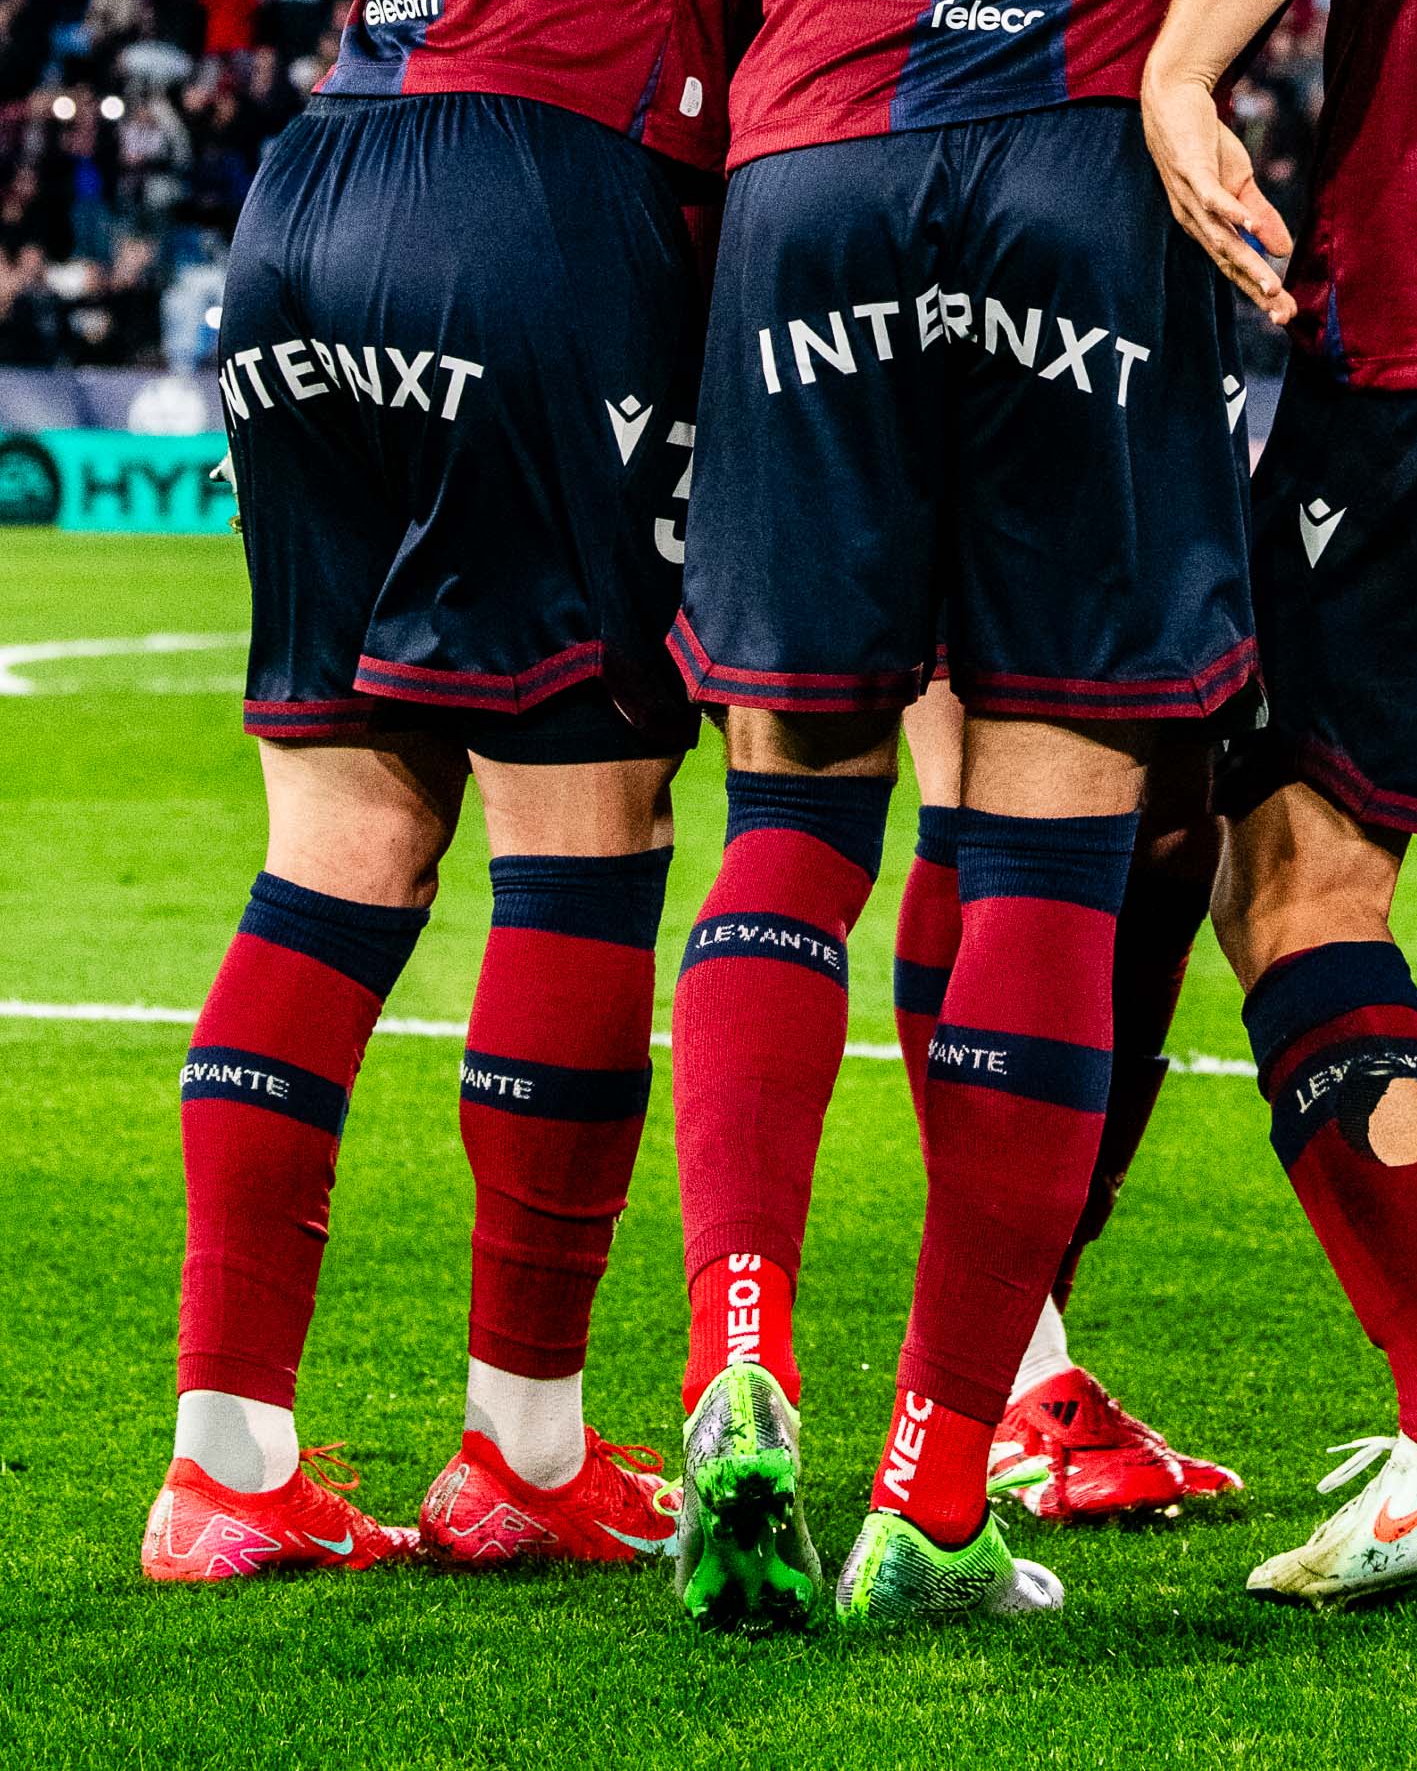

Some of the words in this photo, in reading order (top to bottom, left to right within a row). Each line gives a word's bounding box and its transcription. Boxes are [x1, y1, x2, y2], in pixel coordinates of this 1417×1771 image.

[758, 283, 1151, 407] INTERNXT
[219, 338, 485, 430] NTERNXT
[696, 924, 841, 970] LEVANTE
[928, 1038, 1008, 1076] VANTE
